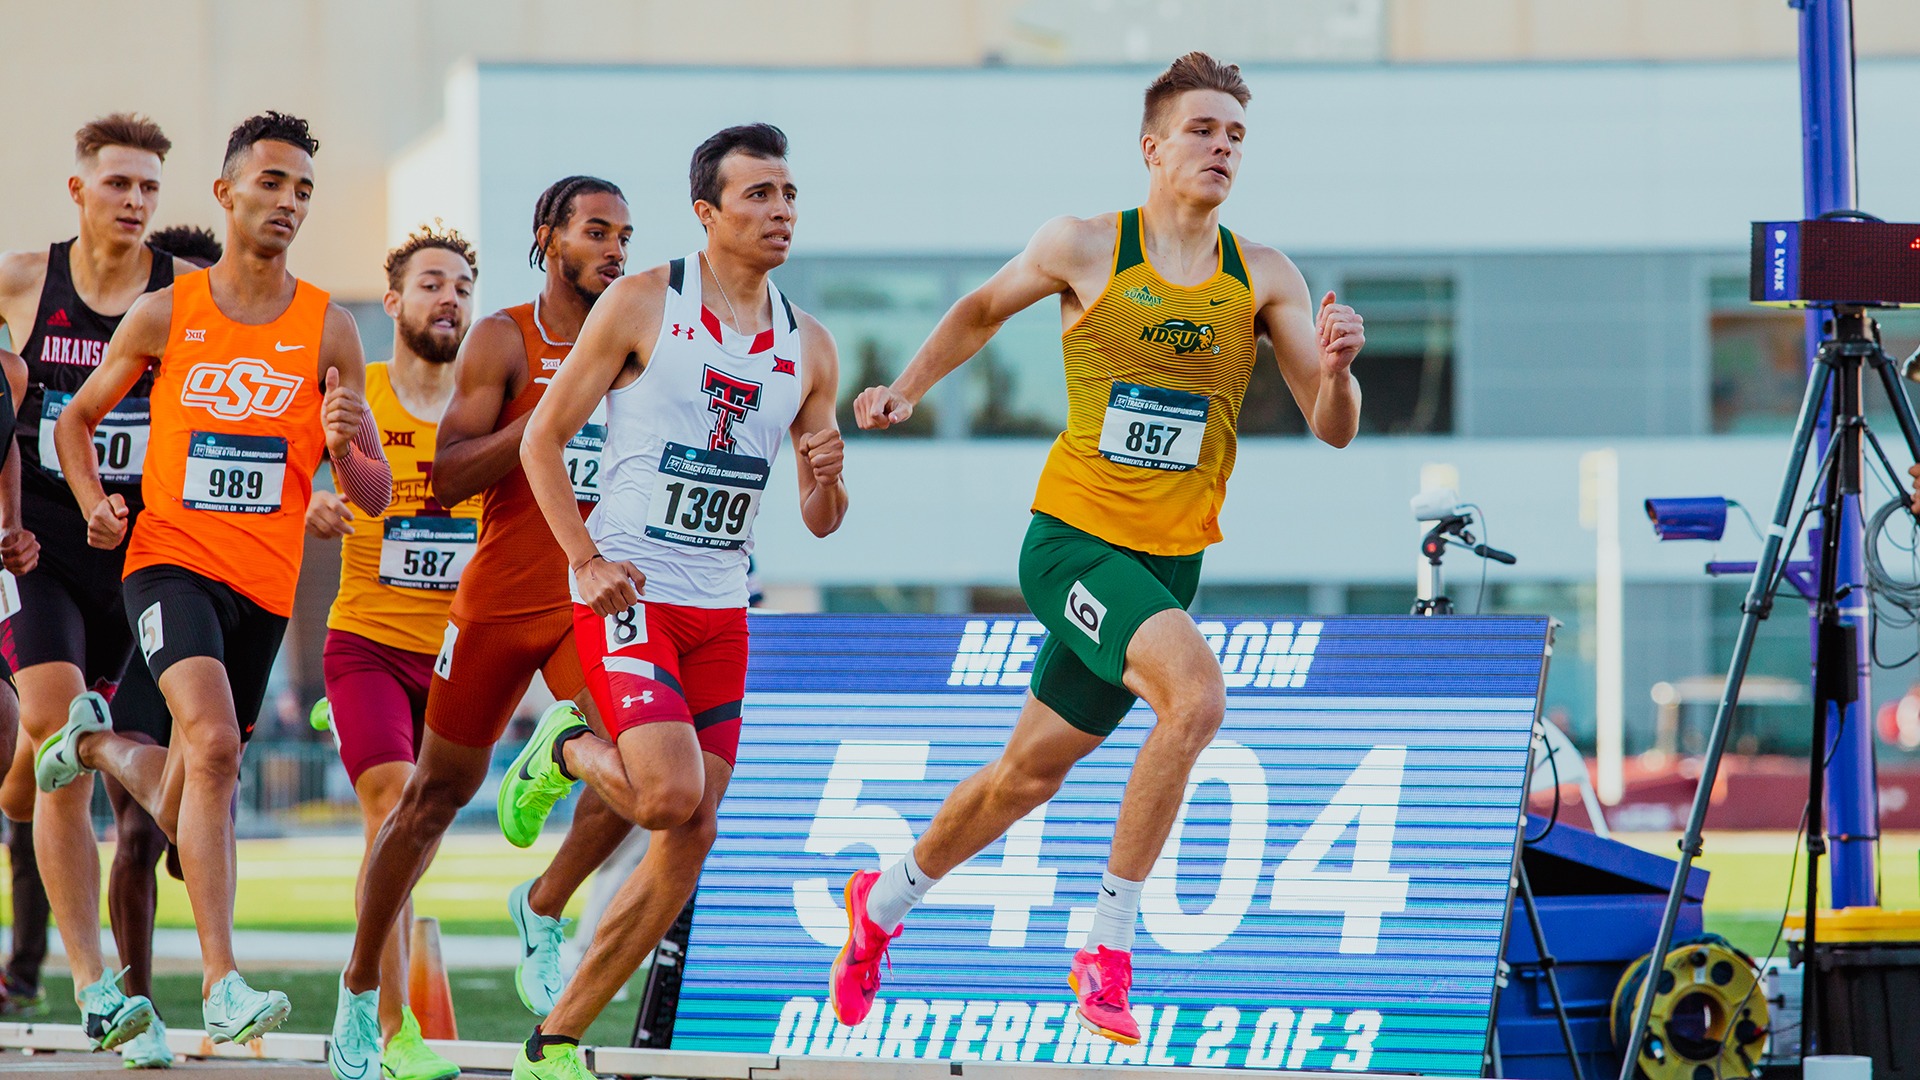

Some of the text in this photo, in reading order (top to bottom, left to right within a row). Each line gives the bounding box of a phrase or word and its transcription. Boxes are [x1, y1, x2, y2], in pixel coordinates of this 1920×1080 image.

[1774, 248, 1786, 291] LYNX
[1123, 290, 1163, 305] SUMMIT
[185, 329, 206, 342] XII
[1138, 325, 1198, 347] NDSU
[772, 355, 796, 376] XII
[181, 357, 304, 420] OSU
[383, 430, 415, 448] XII
[1125, 421, 1182, 456] 857
[209, 468, 263, 500] 989
[681, 462, 701, 474] TRACK
[706, 467, 722, 476] FIELD
[721, 470, 764, 482] CHAMPIONSHIPS
[664, 481, 752, 535] 1399
[403, 549, 456, 577] 587
[612, 606, 638, 645] 8
[1069, 591, 1099, 632] 6
[141, 609, 157, 657] 5
[791, 739, 1411, 954] 54.04
[768, 996, 1384, 1072] QUARTERFINAL 2 OF 3
